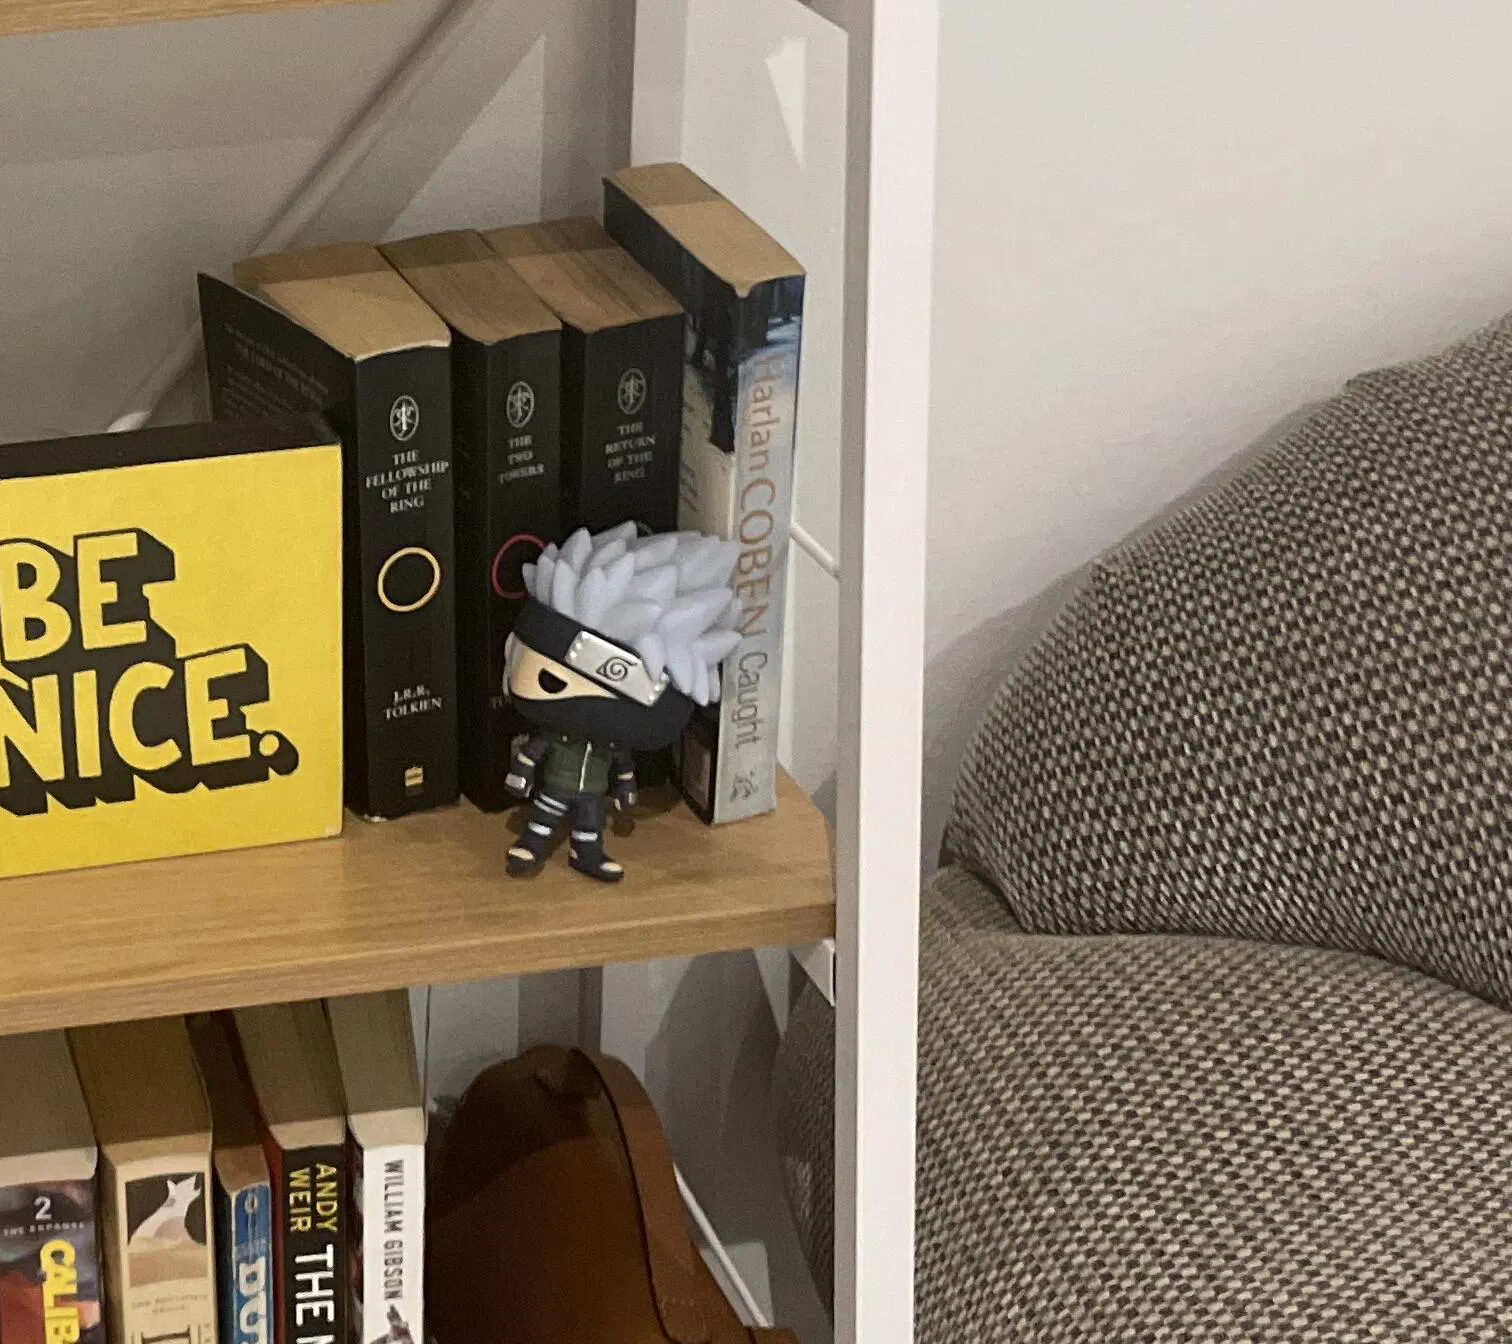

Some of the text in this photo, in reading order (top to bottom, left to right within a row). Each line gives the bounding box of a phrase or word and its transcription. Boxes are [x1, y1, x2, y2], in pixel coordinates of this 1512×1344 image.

[365, 460, 449, 489] FELLOWSHIP
[392, 449, 420, 466] THE
[390, 496, 425, 513] RING
[406, 478, 432, 494] THE
[733, 354, 783, 640] Harlan COBEN
[384, 697, 443, 720] TOLKIEN
[729, 649, 768, 751] Caught
[33, 1196, 53, 1221] 2
[288, 1167, 311, 1232] WEIR
[315, 1161, 337, 1234] ANDY
[383, 1159, 404, 1300] WILLIAM GIBSON
[293, 1244, 335, 1327] THE
